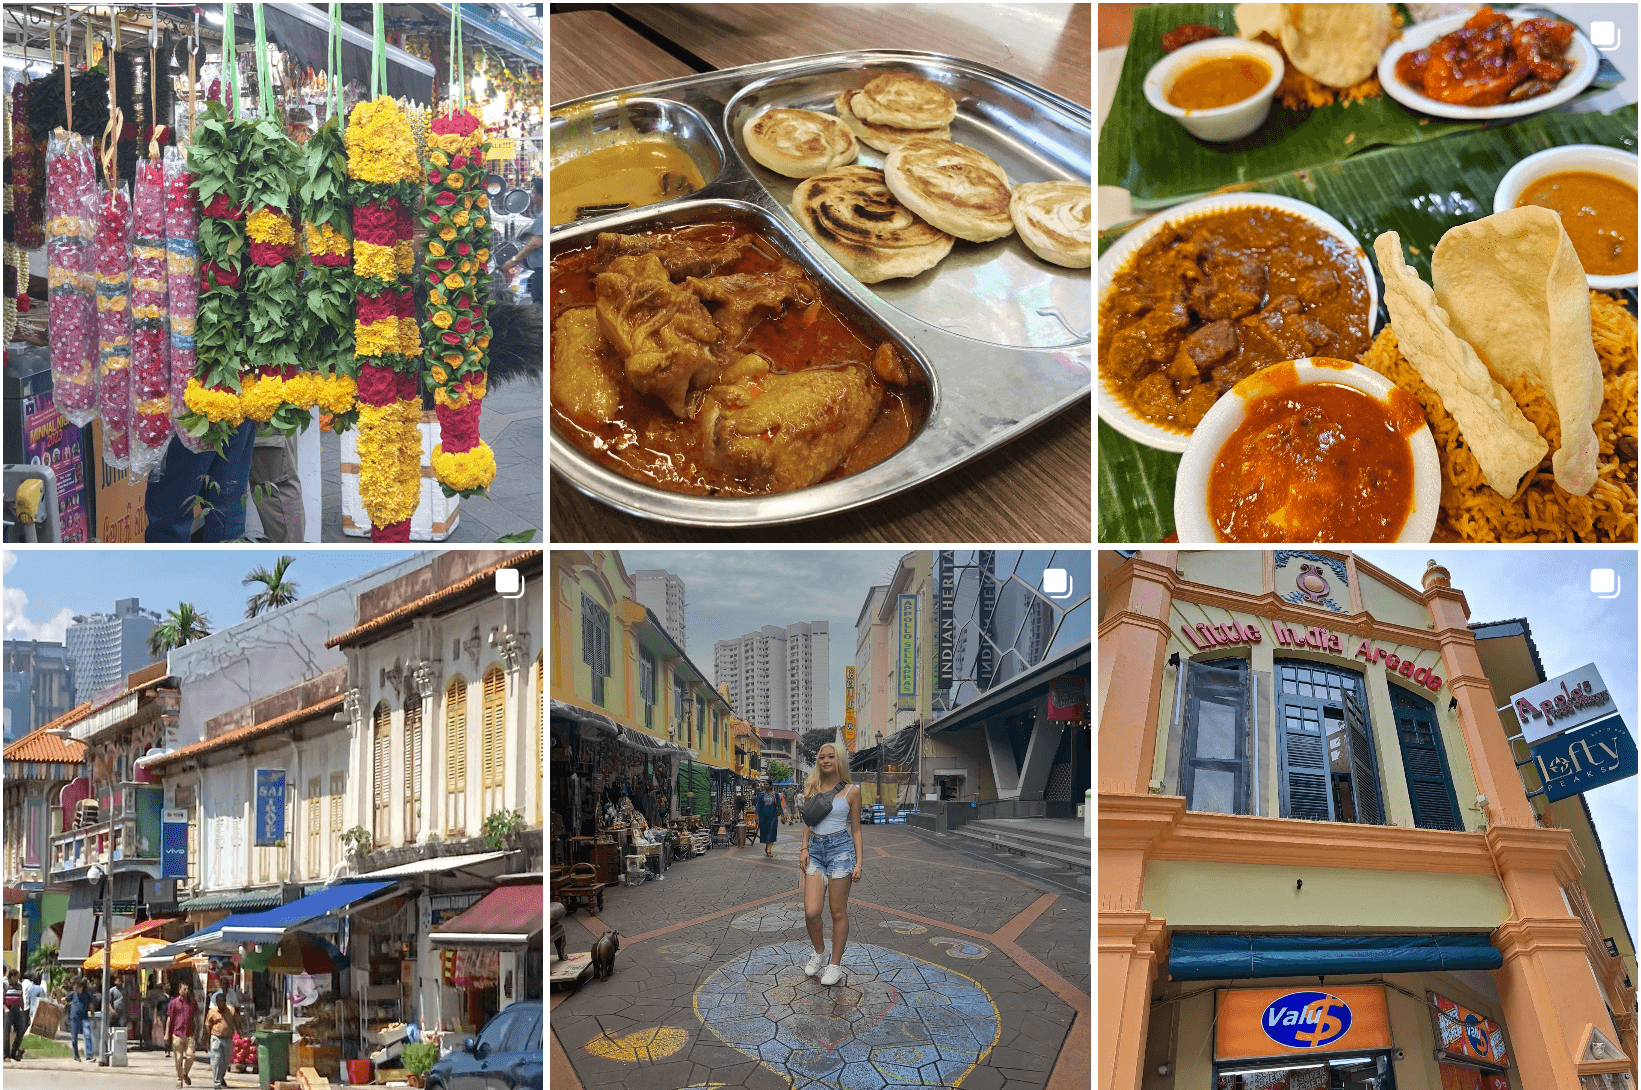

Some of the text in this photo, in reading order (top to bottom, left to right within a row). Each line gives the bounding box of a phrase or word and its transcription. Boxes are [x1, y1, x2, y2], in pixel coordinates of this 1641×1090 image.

[29, 419, 56, 443] MINNAL
[941, 618, 953, 679] INDIAN
[1181, 620, 1443, 692] Little India Arcade
[1546, 766, 1608, 792] PEAKS
[165, 847, 185, 855] vivo
